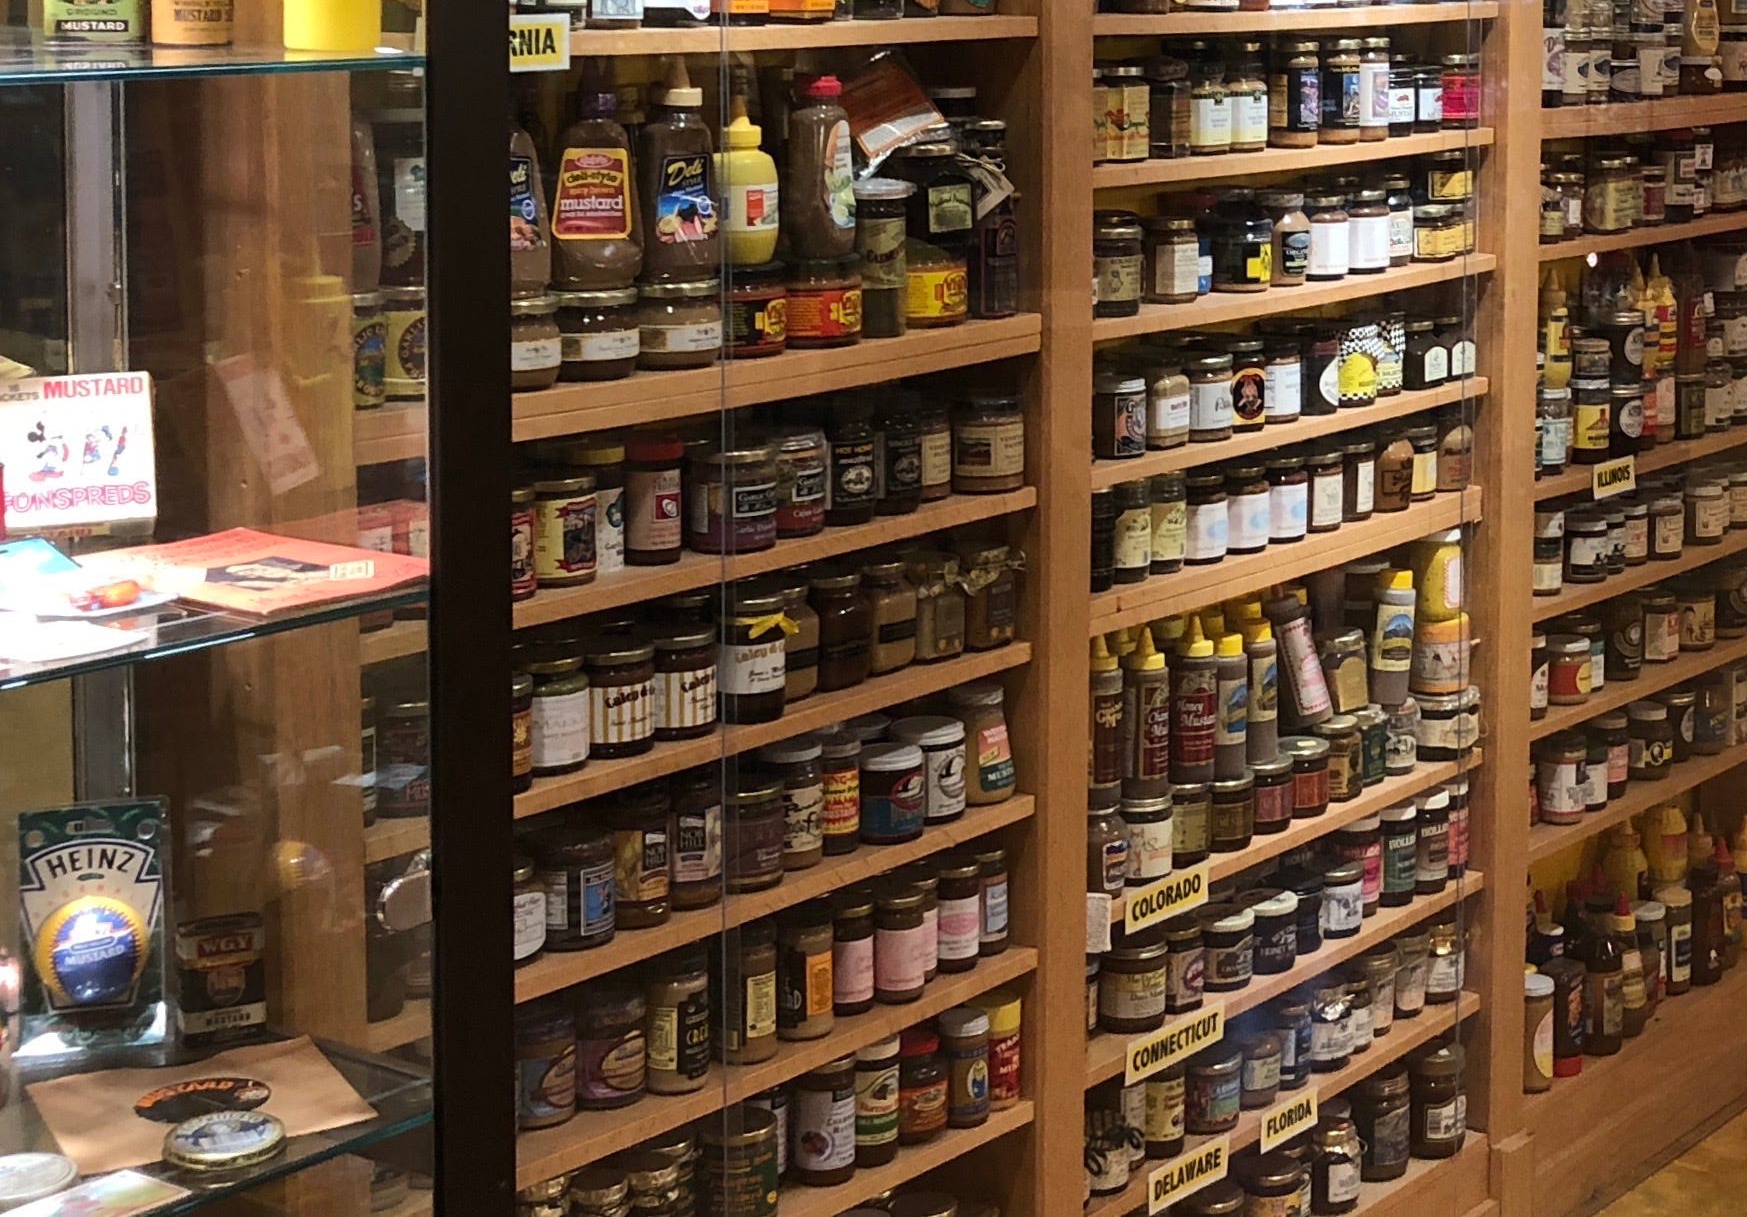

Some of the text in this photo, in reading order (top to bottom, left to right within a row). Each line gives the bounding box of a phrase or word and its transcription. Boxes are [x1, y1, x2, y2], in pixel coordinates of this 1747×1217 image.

[60, 20, 126, 32] MUSTARD
[566, 171, 618, 184] deli-style
[667, 158, 704, 187] Deli
[560, 194, 624, 211] mustard
[44, 376, 143, 400] MUSTARD
[1596, 464, 1631, 489] ILLINOIS
[46, 848, 135, 879] HEINZ
[1131, 873, 1201, 922] COLORADO
[65, 944, 126, 966] MUSTARD
[201, 935, 250, 954] WGY
[1132, 1012, 1219, 1073] CONNECTICUT
[1266, 1098, 1312, 1138] FLORIDA
[1153, 1147, 1222, 1202] DELAWARE
